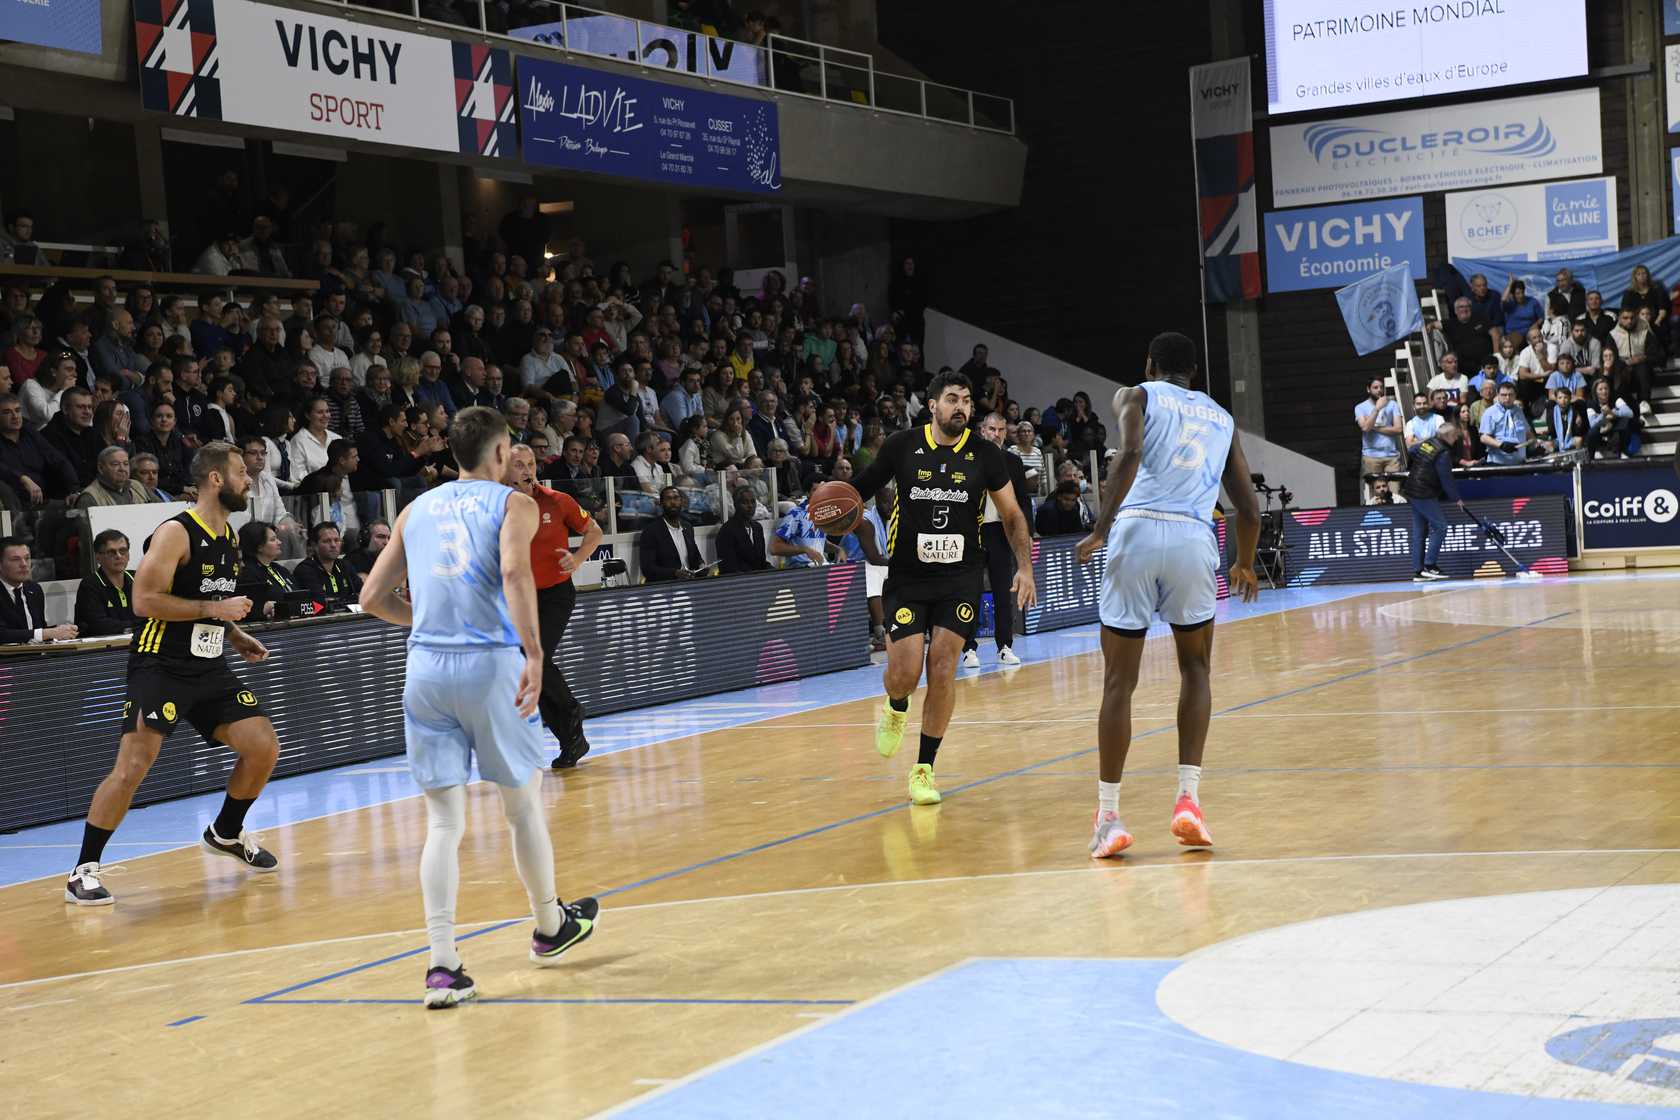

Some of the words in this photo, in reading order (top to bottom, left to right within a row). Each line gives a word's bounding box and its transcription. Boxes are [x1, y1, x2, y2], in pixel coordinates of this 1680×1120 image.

[1292, 10, 1406, 41] PATRIMOINE
[1413, 0, 1505, 26] MONDIAL
[275, 20, 402, 84] VICHY
[1201, 83, 1239, 99] VICHY
[1295, 80, 1352, 99] Grandes
[1355, 76, 1390, 92] villes
[1394, 70, 1441, 87] d'eaux
[1445, 60, 1509, 81] d'Europe
[310, 93, 384, 130] SPORT
[560, 84, 643, 132] LADVIE
[662, 97, 685, 111] VICHY
[708, 118, 734, 132] CUSSET
[1332, 123, 1526, 160] DUCLEROIR
[1532, 154, 1599, 169] CLIMATISATION
[1552, 197, 1567, 211] la
[1570, 193, 1599, 210] mie
[1275, 211, 1412, 252] VICHY
[1300, 253, 1392, 277] Économie
[1172, 423, 1208, 469] 5
[931, 505, 950, 529] 5
[1584, 496, 1642, 518] Coiff
[1654, 496, 1670, 515] &
[430, 523, 470, 577] 3
[922, 551, 959, 560] NATURE
[935, 536, 959, 551] LÉA
[1308, 531, 1349, 559] ALL
[1353, 527, 1410, 556] STAR
